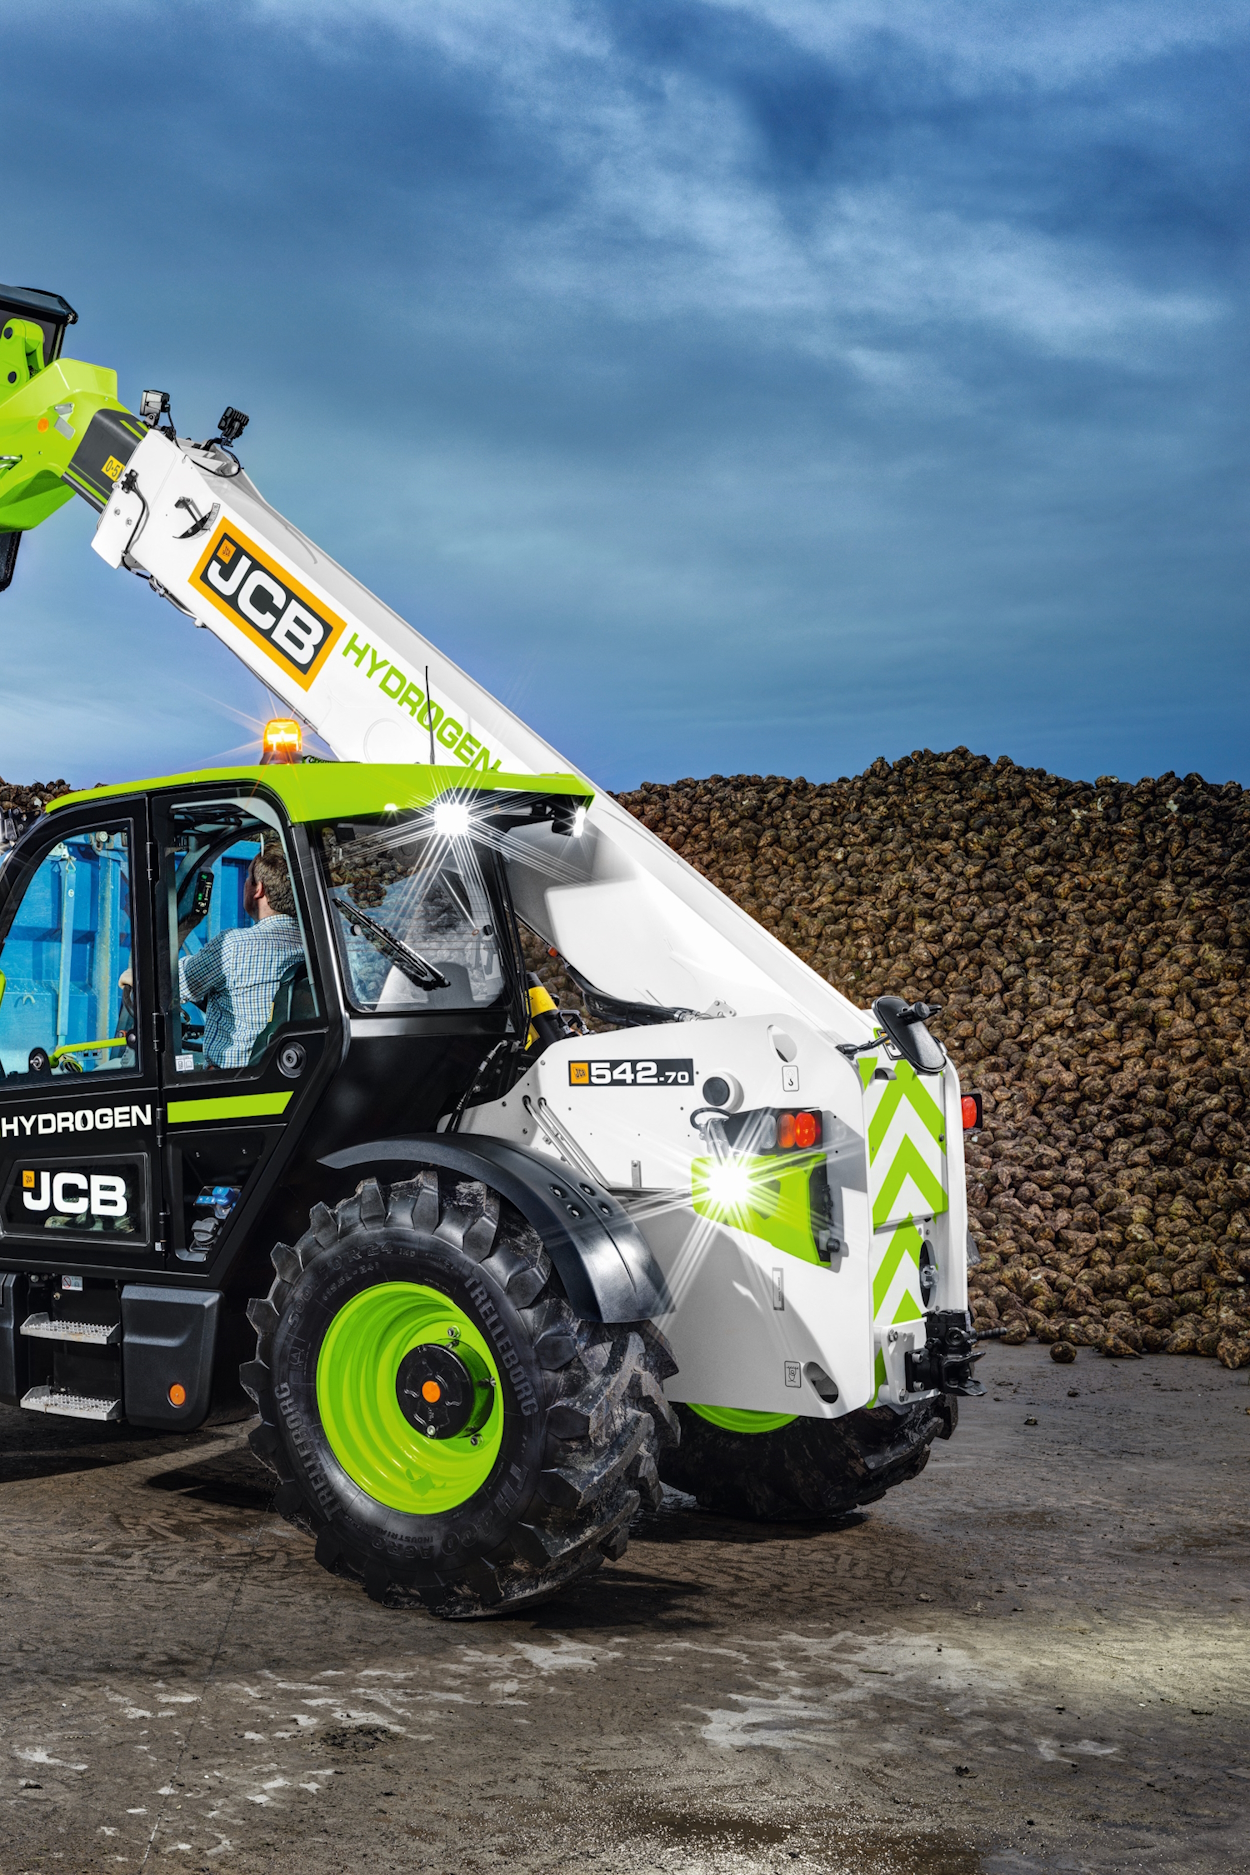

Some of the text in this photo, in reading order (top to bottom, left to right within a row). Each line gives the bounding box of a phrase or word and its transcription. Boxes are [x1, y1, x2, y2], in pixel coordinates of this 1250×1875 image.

[207, 555, 502, 772] JCB HYDROGEN
[590, 1061, 690, 1084] 542-70
[1, 1104, 152, 1138] HYDROGEN
[22, 1171, 128, 1217] JCB
[366, 1239, 394, 1257] 24
[463, 1276, 539, 1418] TRELLEBORG
[274, 1381, 343, 1522] TRELLEBORG
[493, 1462, 530, 1517] TH
[371, 1536, 435, 1560] AGRO
